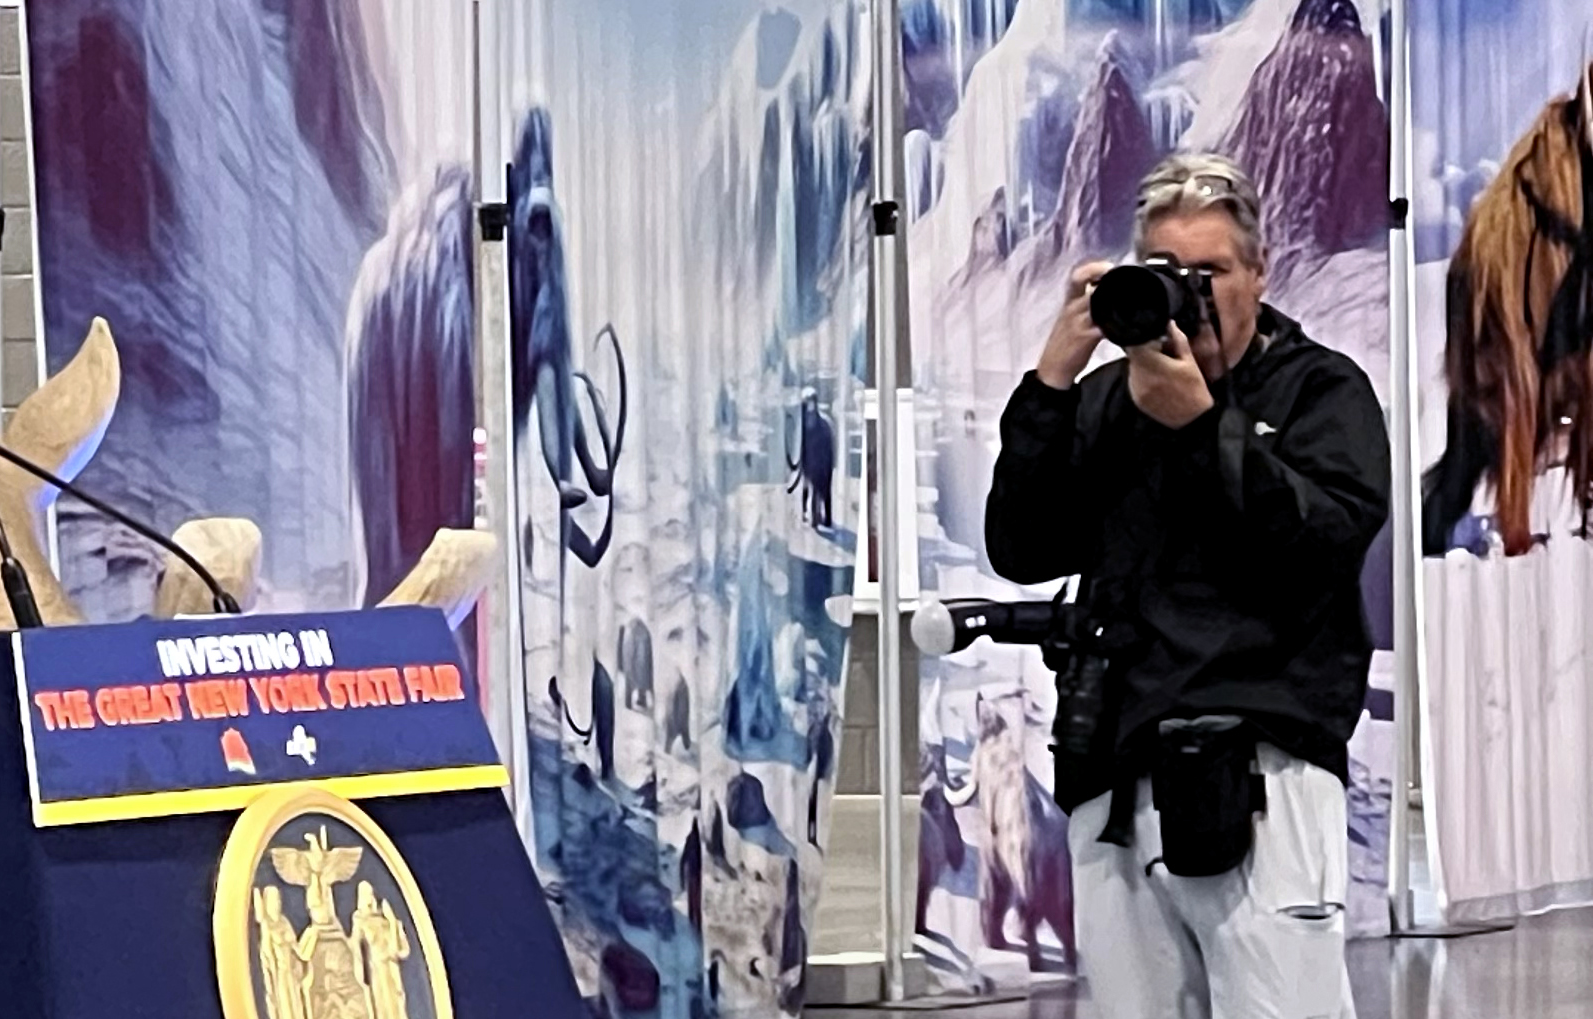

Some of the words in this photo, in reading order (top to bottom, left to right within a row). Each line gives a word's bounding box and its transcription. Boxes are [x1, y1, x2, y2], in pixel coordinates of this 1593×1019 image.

[157, 631, 301, 678] INVESTING
[298, 629, 334, 667] IN
[34, 689, 96, 731] THE
[95, 682, 183, 726] GREAT
[184, 678, 249, 720] NEW
[248, 673, 328, 715] YORK
[324, 667, 406, 710] STATE
[402, 664, 465, 702] FAIR
